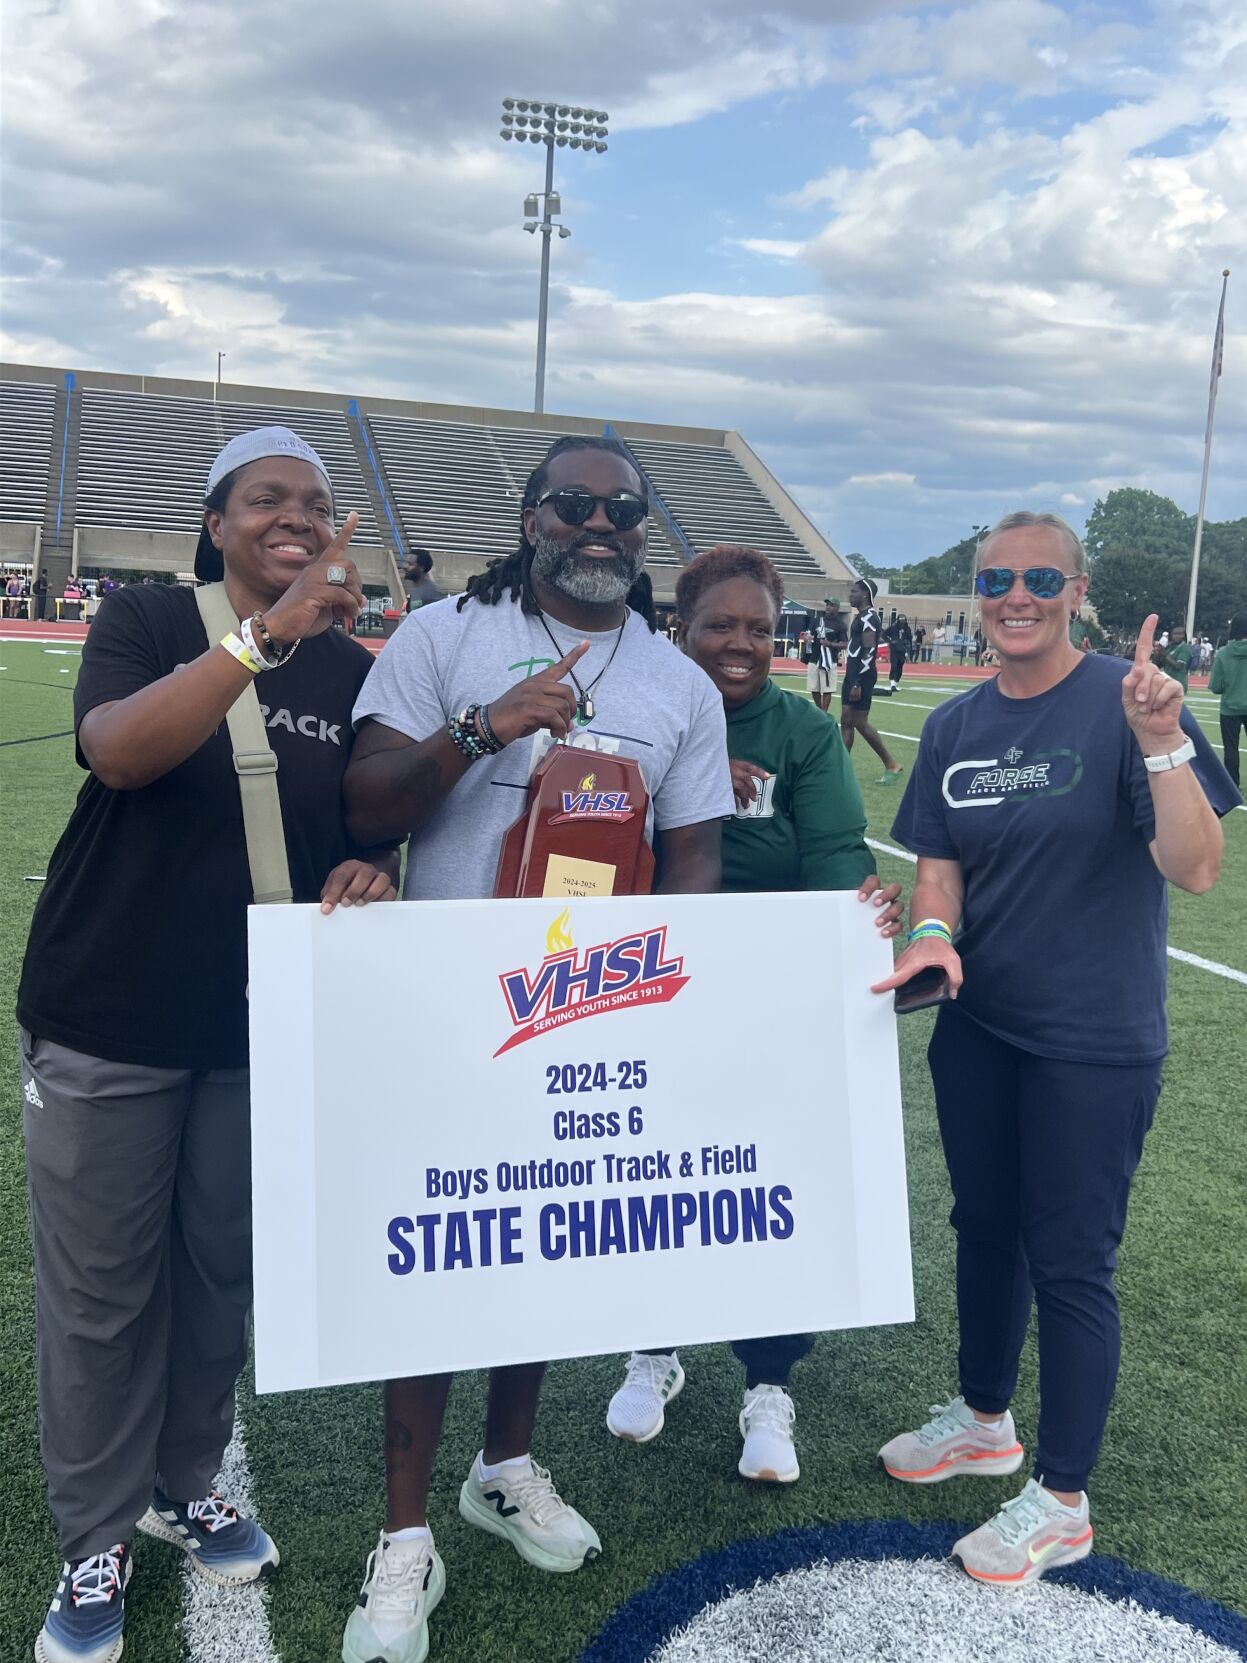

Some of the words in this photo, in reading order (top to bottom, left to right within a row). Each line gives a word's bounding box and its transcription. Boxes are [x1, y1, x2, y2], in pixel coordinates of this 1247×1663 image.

[259, 703, 342, 746] RACK
[970, 763, 1050, 789] FORGE
[562, 792, 632, 812] VHSL
[562, 877, 596, 888] 2024-2025
[502, 928, 682, 1024] VHSL
[533, 1008, 576, 1033] SERVING
[576, 998, 610, 1016] YOUTH
[611, 990, 639, 1006] SINCE
[640, 985, 663, 997] 1913
[545, 1060, 648, 1095] 2024-25
[553, 1110, 620, 1141] Class
[628, 1106, 643, 1136] 6
[426, 1165, 489, 1200] Boys
[496, 1156, 596, 1193] Outdoor
[603, 1150, 672, 1183] Track
[679, 1151, 694, 1177] &
[701, 1144, 758, 1176] Field
[387, 1206, 524, 1276] STATE
[539, 1185, 795, 1262] CHAMPIONS
